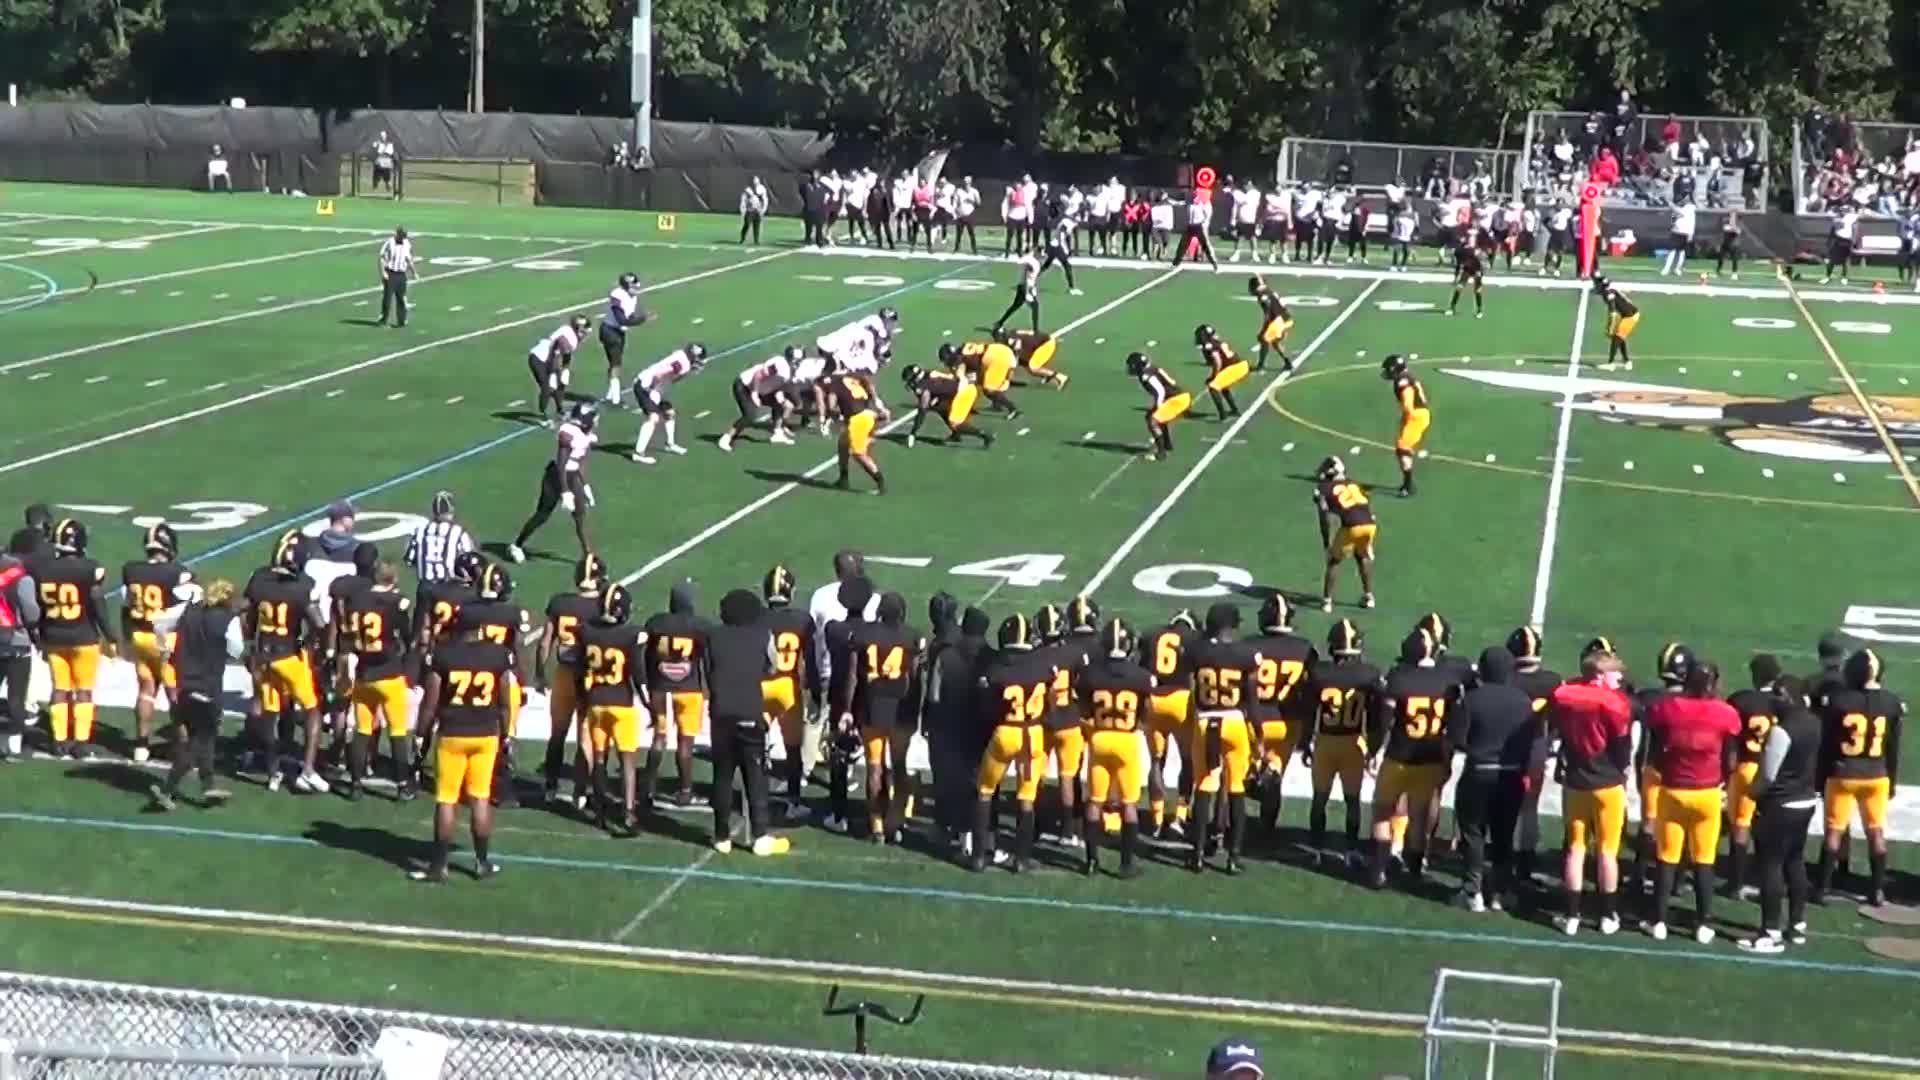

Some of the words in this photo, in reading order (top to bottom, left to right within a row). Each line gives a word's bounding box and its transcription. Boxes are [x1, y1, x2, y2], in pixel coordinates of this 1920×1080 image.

[948, 554, 1253, 597] 40
[39, 583, 81, 619] 50
[866, 644, 903, 680] 14
[1154, 633, 1179, 674] 6
[448, 671, 496, 706] 73
[1198, 667, 1242, 707] 85
[1255, 659, 1303, 702] 97
[1002, 682, 1045, 721] 34
[1841, 713, 1885, 757] 31
